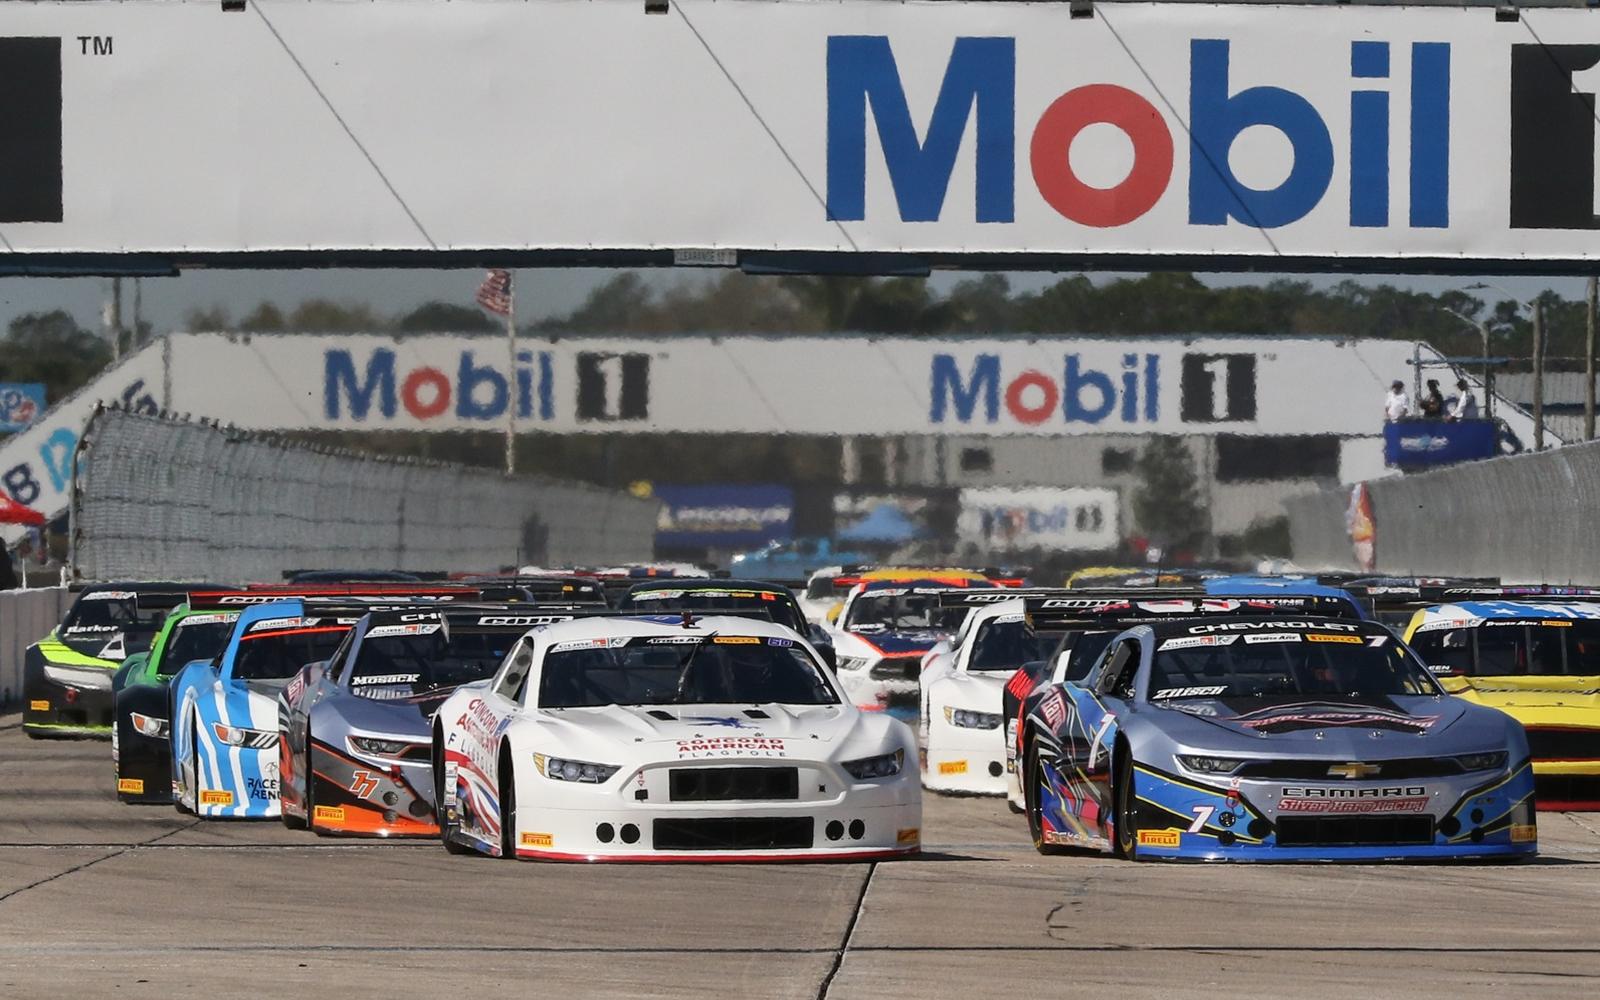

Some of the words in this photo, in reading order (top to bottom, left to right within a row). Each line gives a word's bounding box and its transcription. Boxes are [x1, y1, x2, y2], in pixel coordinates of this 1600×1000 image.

[77, 36, 113, 55] TM
[826, 35, 1450, 229] Mobil
[324, 347, 556, 422] Mobil
[929, 352, 1160, 427] Mobil
[1188, 621, 1358, 634] CHEVROLET
[1365, 636, 1388, 648] 7
[676, 737, 783, 746] CONCORD
[678, 743, 785, 752] AMERICAN
[678, 750, 786, 758] FLAGPOLE
[248, 777, 277, 789] RACE
[1282, 786, 1426, 798] CAMARO
[1278, 798, 1330, 812] Silver
[1188, 806, 1215, 832] 7
[1140, 832, 1177, 844] PIRELLI
